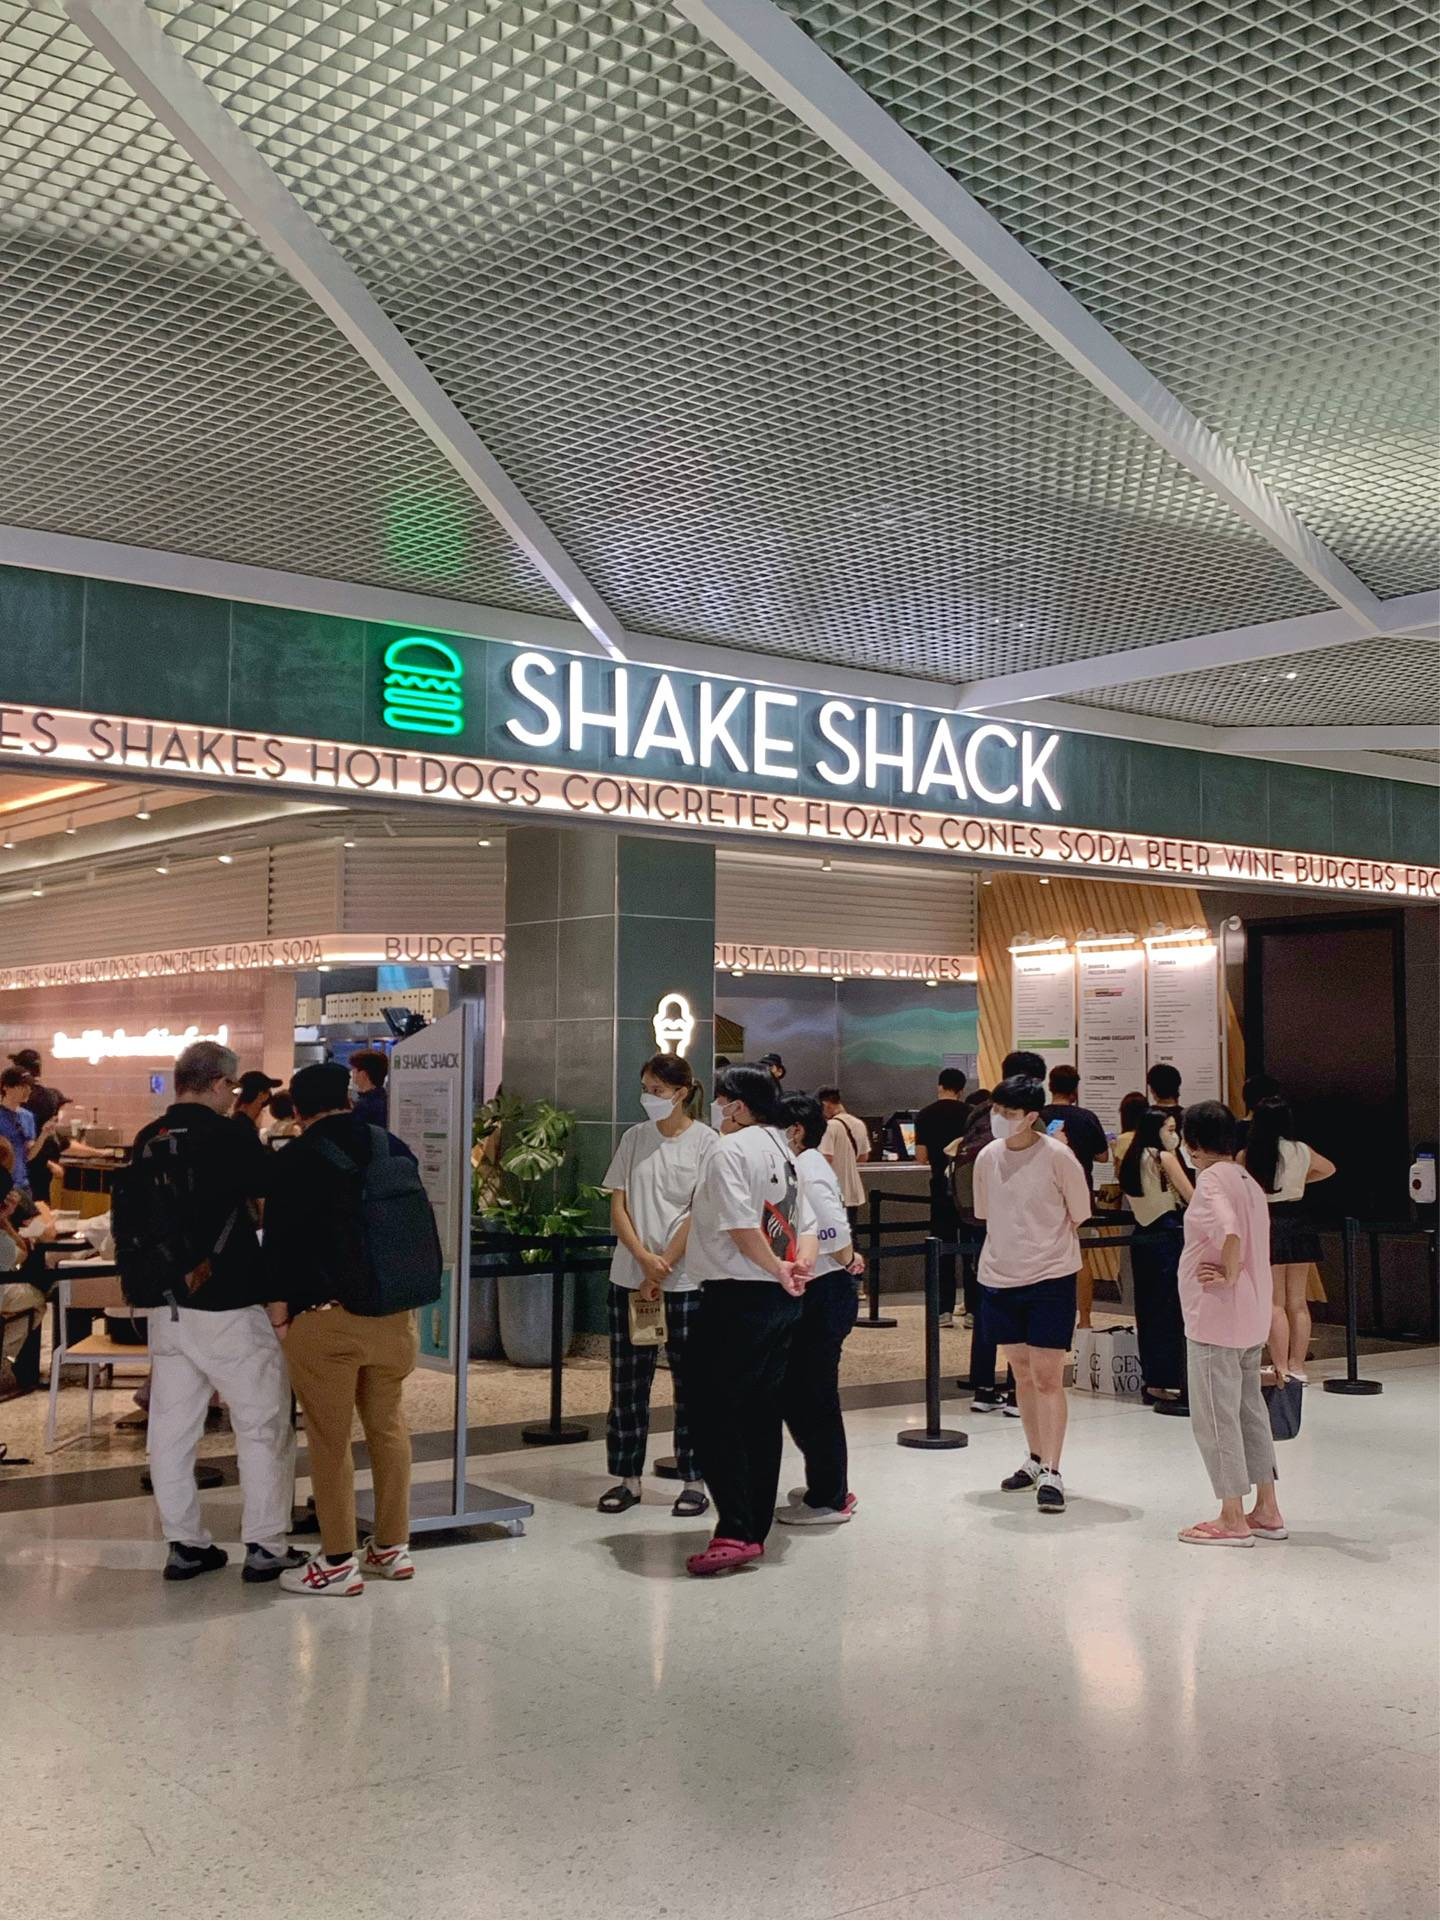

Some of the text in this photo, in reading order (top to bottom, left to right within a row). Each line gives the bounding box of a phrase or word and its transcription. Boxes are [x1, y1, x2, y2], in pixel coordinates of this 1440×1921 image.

[505, 652, 1062, 811] SHAKE SHACK
[0, 709, 58, 754] ES
[87, 718, 287, 779] SHAKES
[310, 743, 407, 790] HOT
[420, 757, 542, 805] DOGS
[561, 774, 789, 832] CONCRETES
[806, 802, 924, 845] FLOATS
[939, 818, 1043, 857] CONES
[1058, 830, 1133, 865] SODA
[1147, 840, 1210, 875] BEER
[1224, 847, 1284, 880] WINE
[1296, 856, 1396, 891] BURGERS
[109, 956, 141, 979] DOGS
[145, 947, 220, 975] CONCRETES
[225, 943, 274, 969] FLOATS
[283, 939, 322, 963] SODA
[385, 937, 505, 961] BURGER
[817, 951, 875, 976] FRIES
[884, 955, 960, 979] SHAKES
[402, 1053, 459, 1070] SHAKE SHACK
[1112, 1375, 1140, 1392] WO
